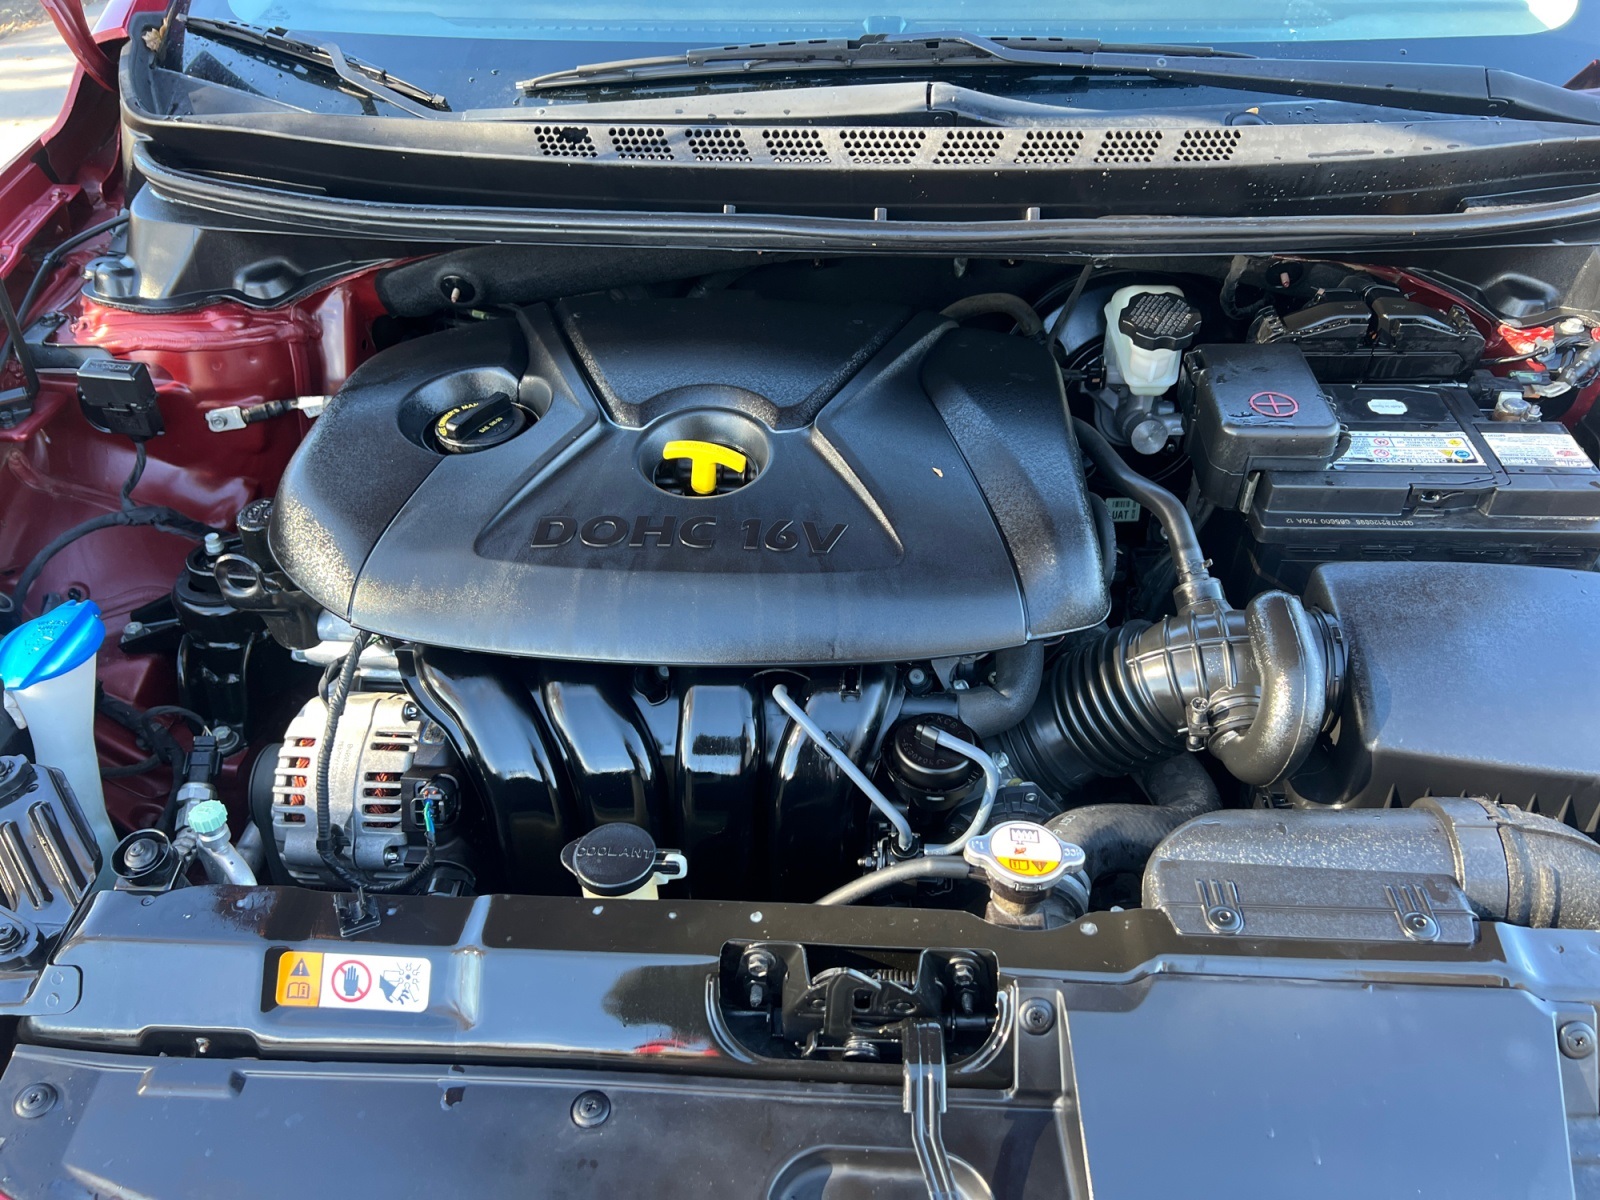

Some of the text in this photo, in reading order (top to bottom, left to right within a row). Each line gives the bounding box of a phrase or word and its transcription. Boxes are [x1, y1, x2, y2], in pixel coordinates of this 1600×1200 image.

[1112, 510, 1130, 520] UAT
[531, 515, 850, 554] DOHC 16V
[576, 845, 654, 860] COOLANT
